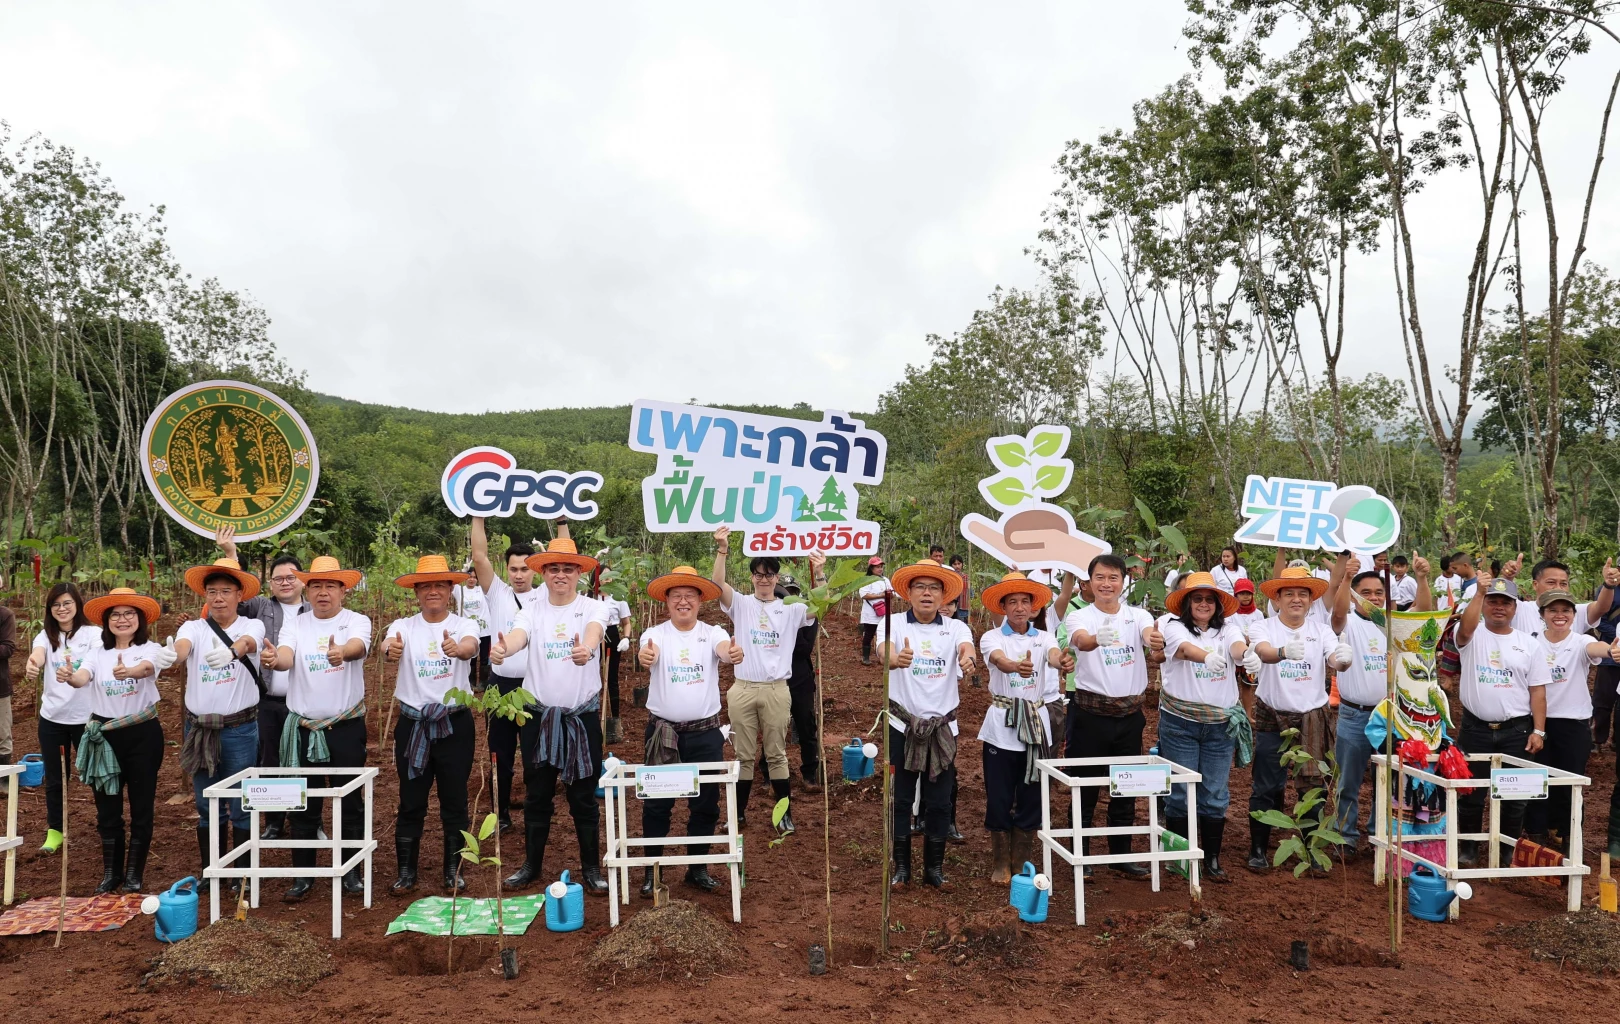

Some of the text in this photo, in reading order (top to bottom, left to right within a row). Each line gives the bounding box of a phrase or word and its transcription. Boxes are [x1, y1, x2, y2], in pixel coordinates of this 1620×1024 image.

[166, 388, 286, 427] กรมป่าไม้
[636, 407, 879, 478] เพาะกล้า
[163, 478, 305, 531] ROYAL FOREST DEPARTMENT
[463, 471, 599, 515] GPSC
[653, 454, 806, 525] ฟื้นป่า
[1248, 479, 1332, 510] NET
[750, 524, 873, 551] สร้างชีวิต
